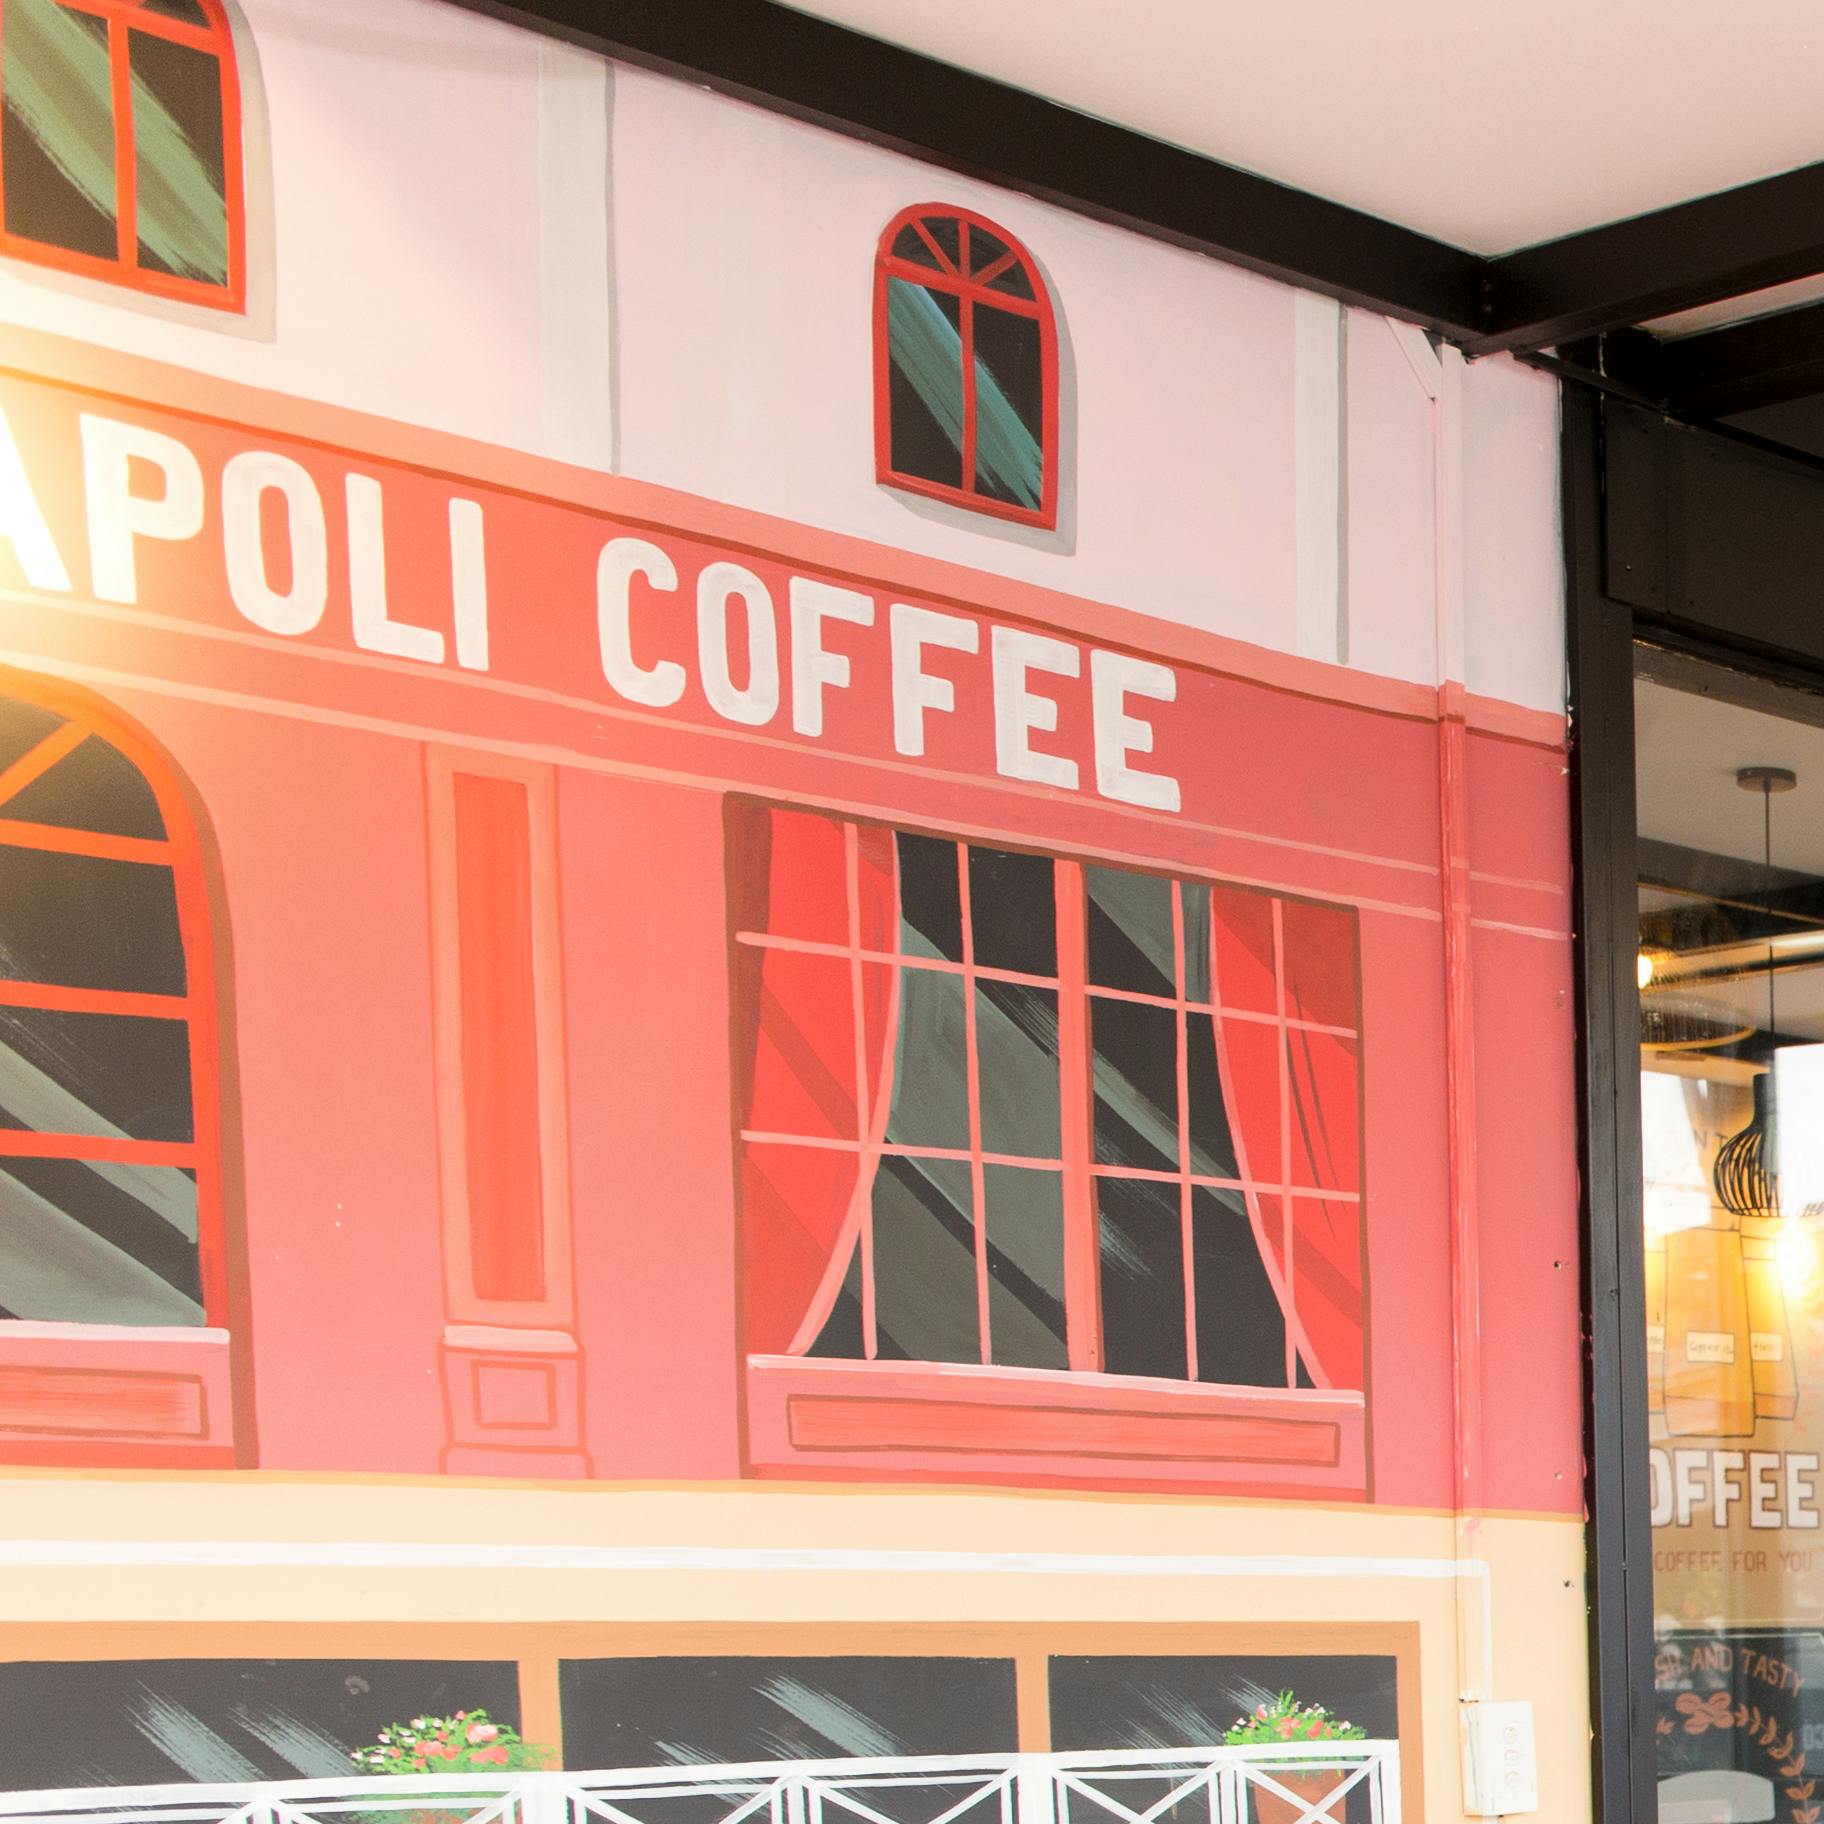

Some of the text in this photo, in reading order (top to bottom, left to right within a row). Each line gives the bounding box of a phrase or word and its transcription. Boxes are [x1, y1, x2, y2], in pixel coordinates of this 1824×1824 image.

[597, 537, 1182, 811] COFFEE
[1654, 1550, 1812, 1573] COFFEE FOR YOU
[1691, 1645, 1735, 1672] AND
[1741, 1648, 1806, 1697] TASTY
